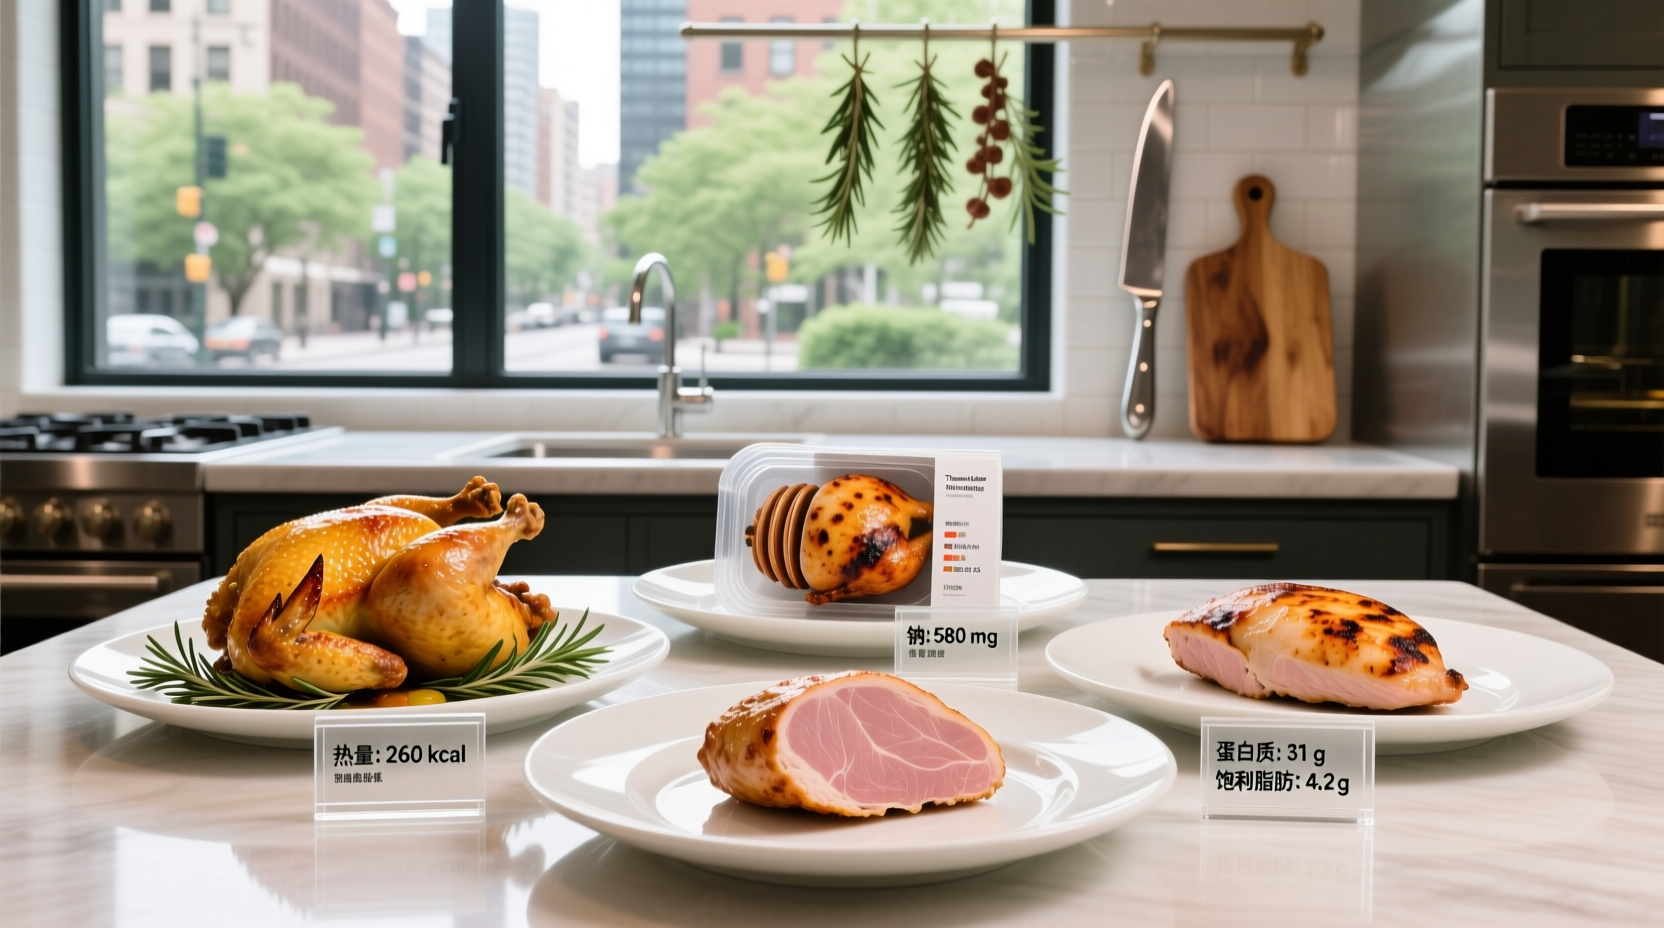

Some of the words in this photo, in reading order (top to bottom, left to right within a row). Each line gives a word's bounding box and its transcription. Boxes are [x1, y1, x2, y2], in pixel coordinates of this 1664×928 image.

[970, 631, 998, 648] mg
[385, 744, 423, 764] 260
[428, 744, 466, 763] kcal
[1216, 740, 1281, 763] 蛋白质:
[1287, 743, 1306, 761] 31
[1313, 749, 1326, 767] g
